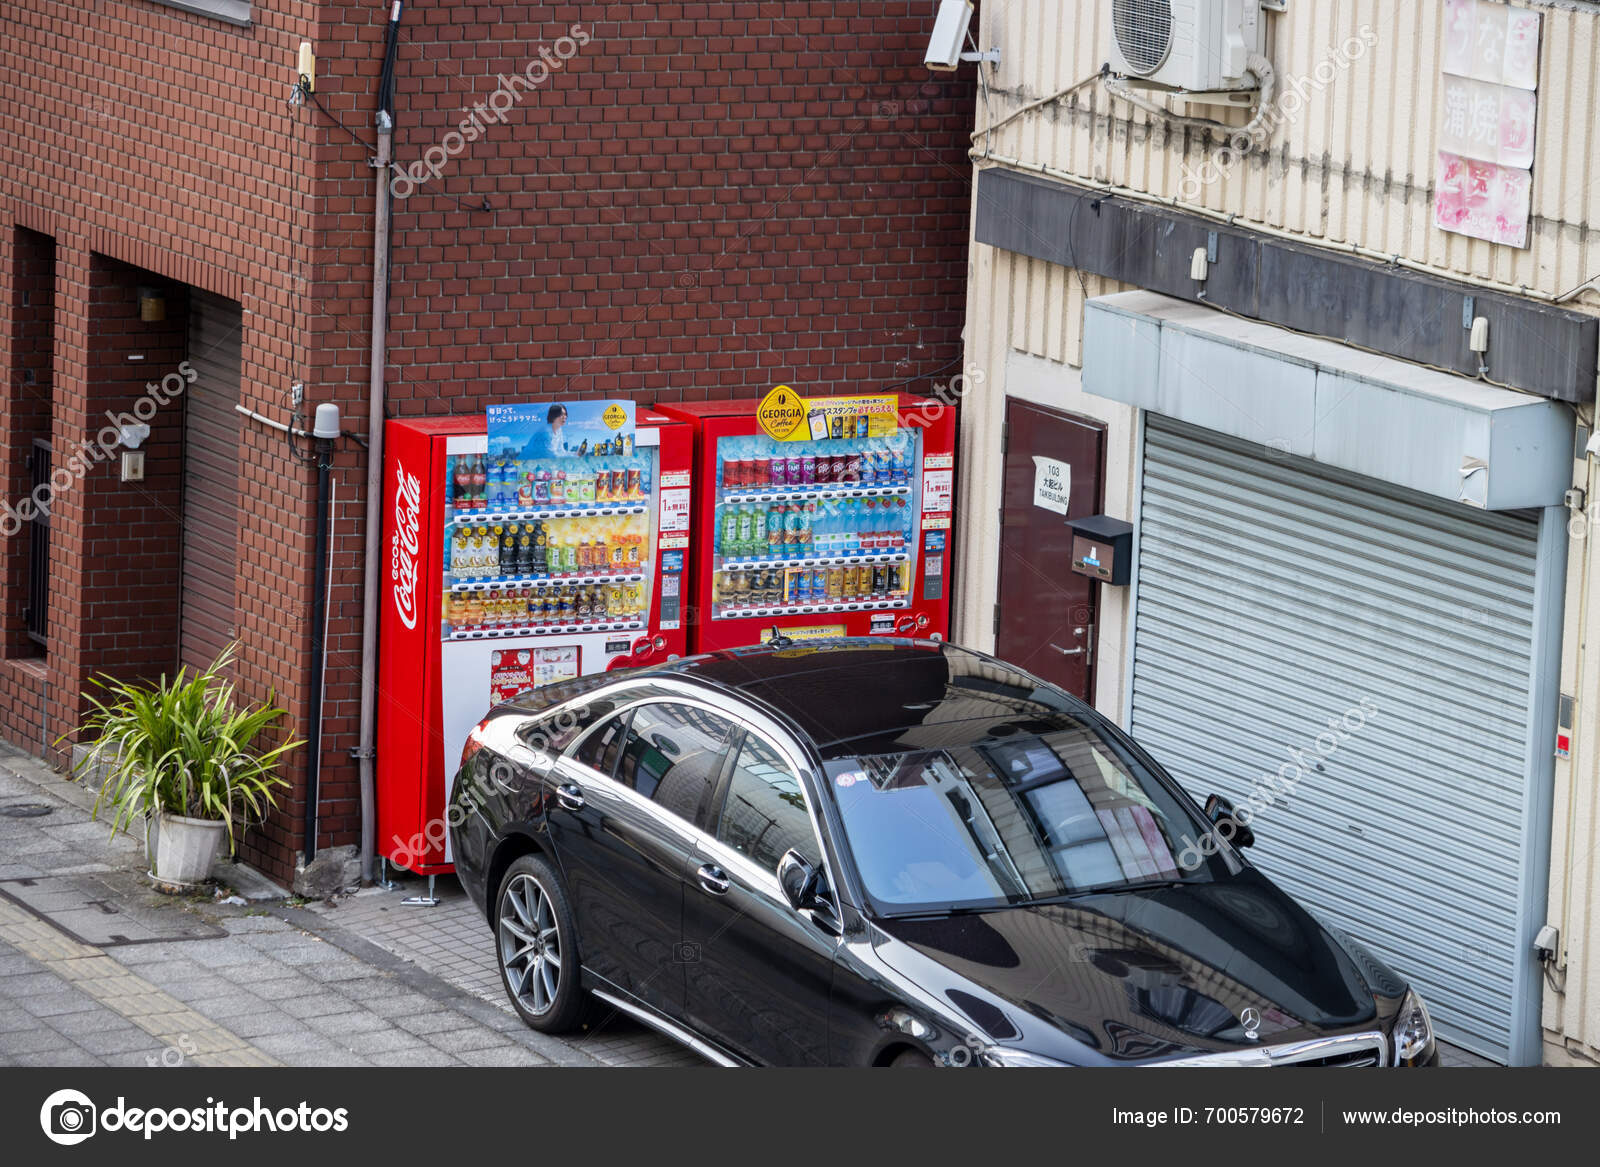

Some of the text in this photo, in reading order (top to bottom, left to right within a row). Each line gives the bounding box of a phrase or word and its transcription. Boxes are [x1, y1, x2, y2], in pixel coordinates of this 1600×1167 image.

[762, 408, 801, 419] GEORGIA
[771, 418, 793, 429] Coffee
[1048, 465, 1060, 477] 103
[394, 459, 421, 630] Coca-Cola
